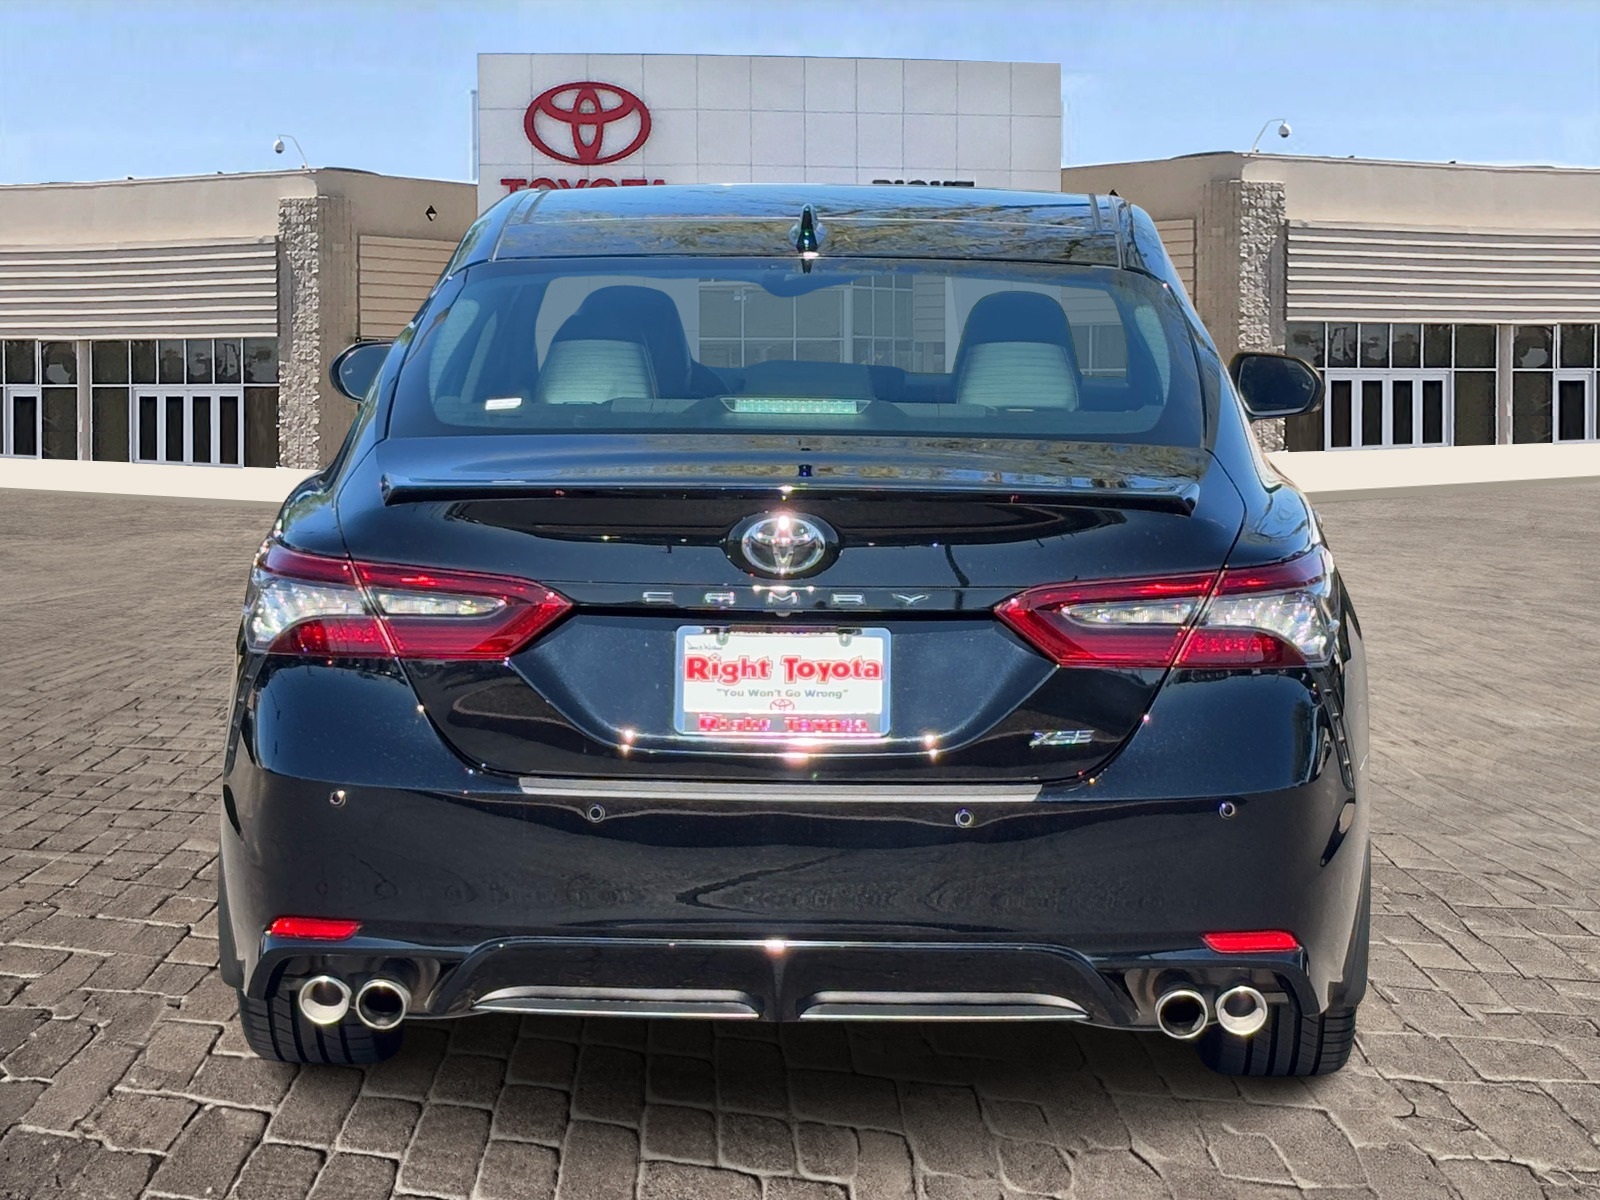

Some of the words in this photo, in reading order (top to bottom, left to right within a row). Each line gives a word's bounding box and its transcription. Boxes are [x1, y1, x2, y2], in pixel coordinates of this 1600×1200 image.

[684, 654, 772, 685] Right
[781, 655, 883, 684] Toyota
[716, 687, 744, 698] "You
[747, 688, 781, 698] Won't
[785, 688, 801, 698] Go
[805, 688, 849, 700] Wrong"
